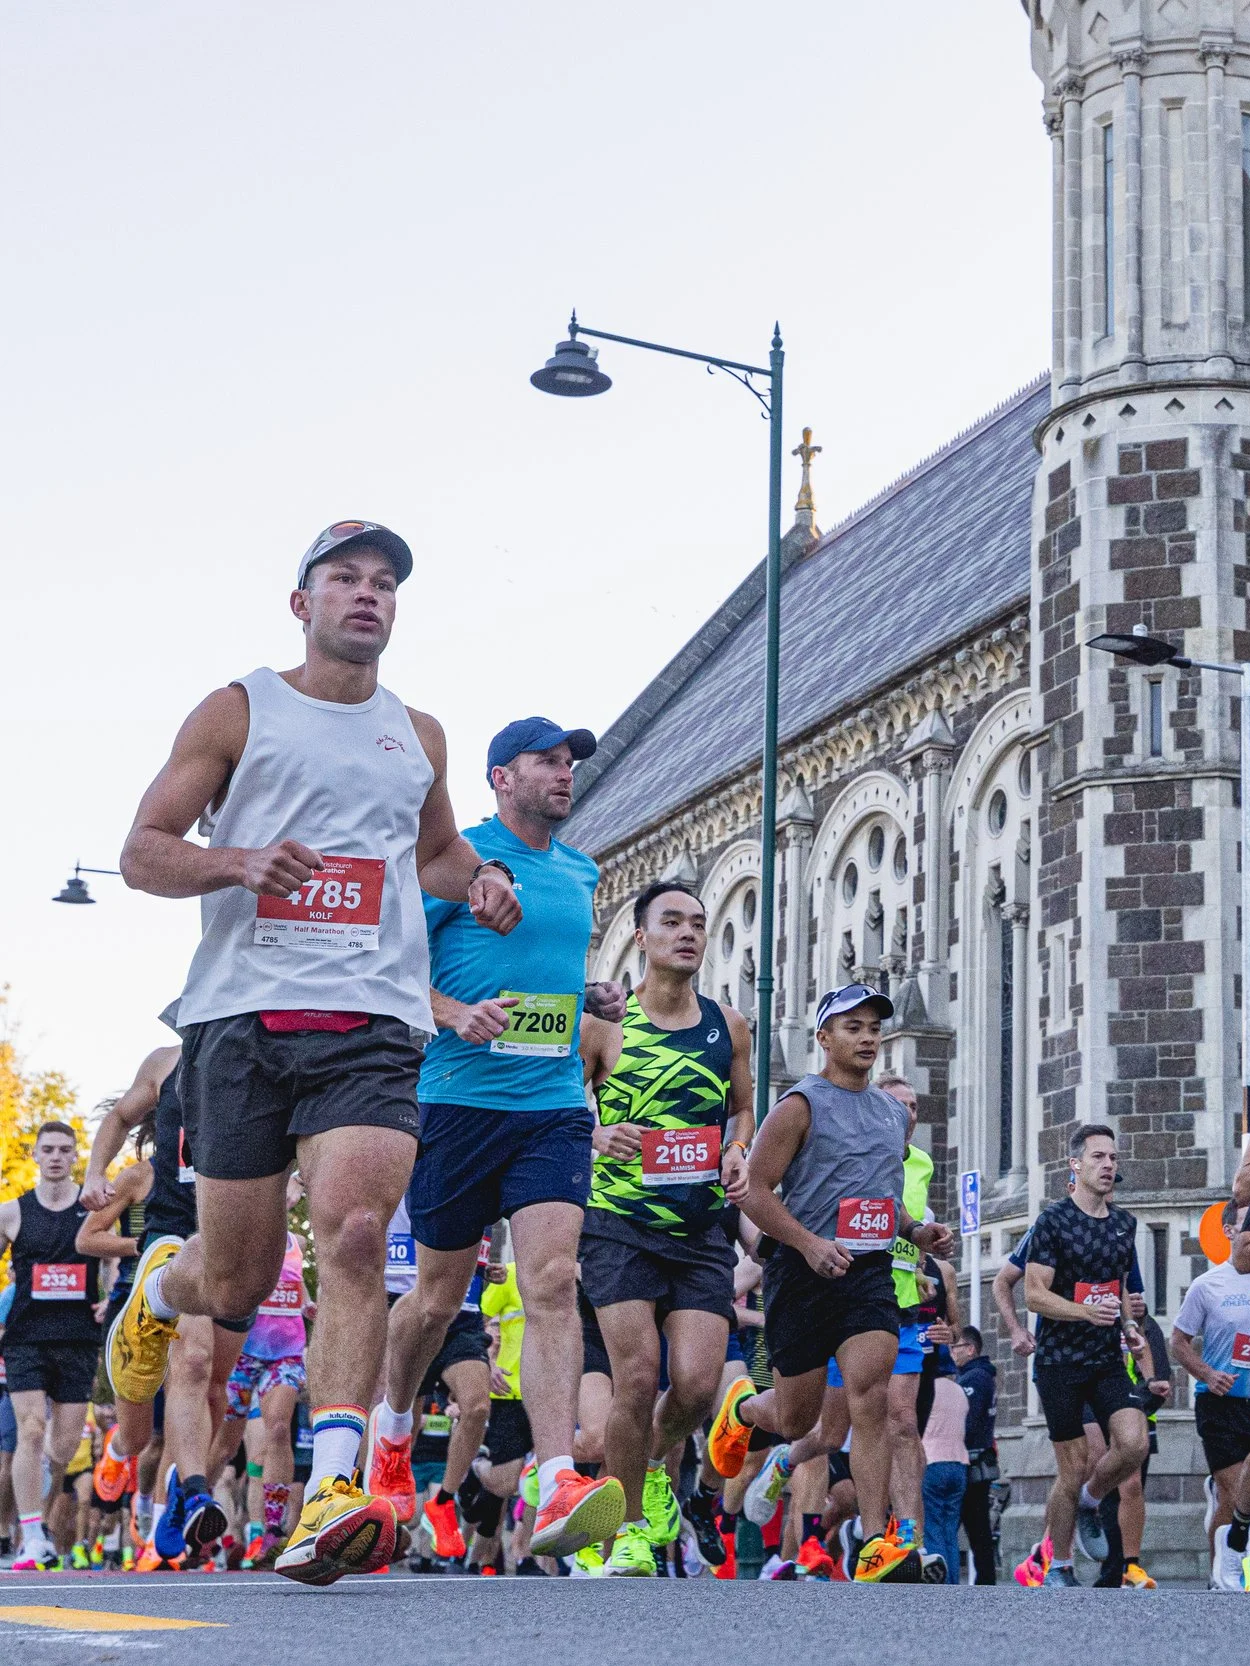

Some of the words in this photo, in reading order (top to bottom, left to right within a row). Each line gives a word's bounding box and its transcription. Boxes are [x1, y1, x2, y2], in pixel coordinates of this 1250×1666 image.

[324, 861, 353, 869] ristchurch
[309, 911, 333, 920] KOLF
[310, 927, 345, 935] Marathon
[347, 941, 364, 949] 4785
[512, 1011, 567, 1033] 7208
[655, 1143, 708, 1164] 2165
[849, 1213, 889, 1231] 4548
[41, 1273, 77, 1287] 2324
[269, 1289, 298, 1303] 2515
